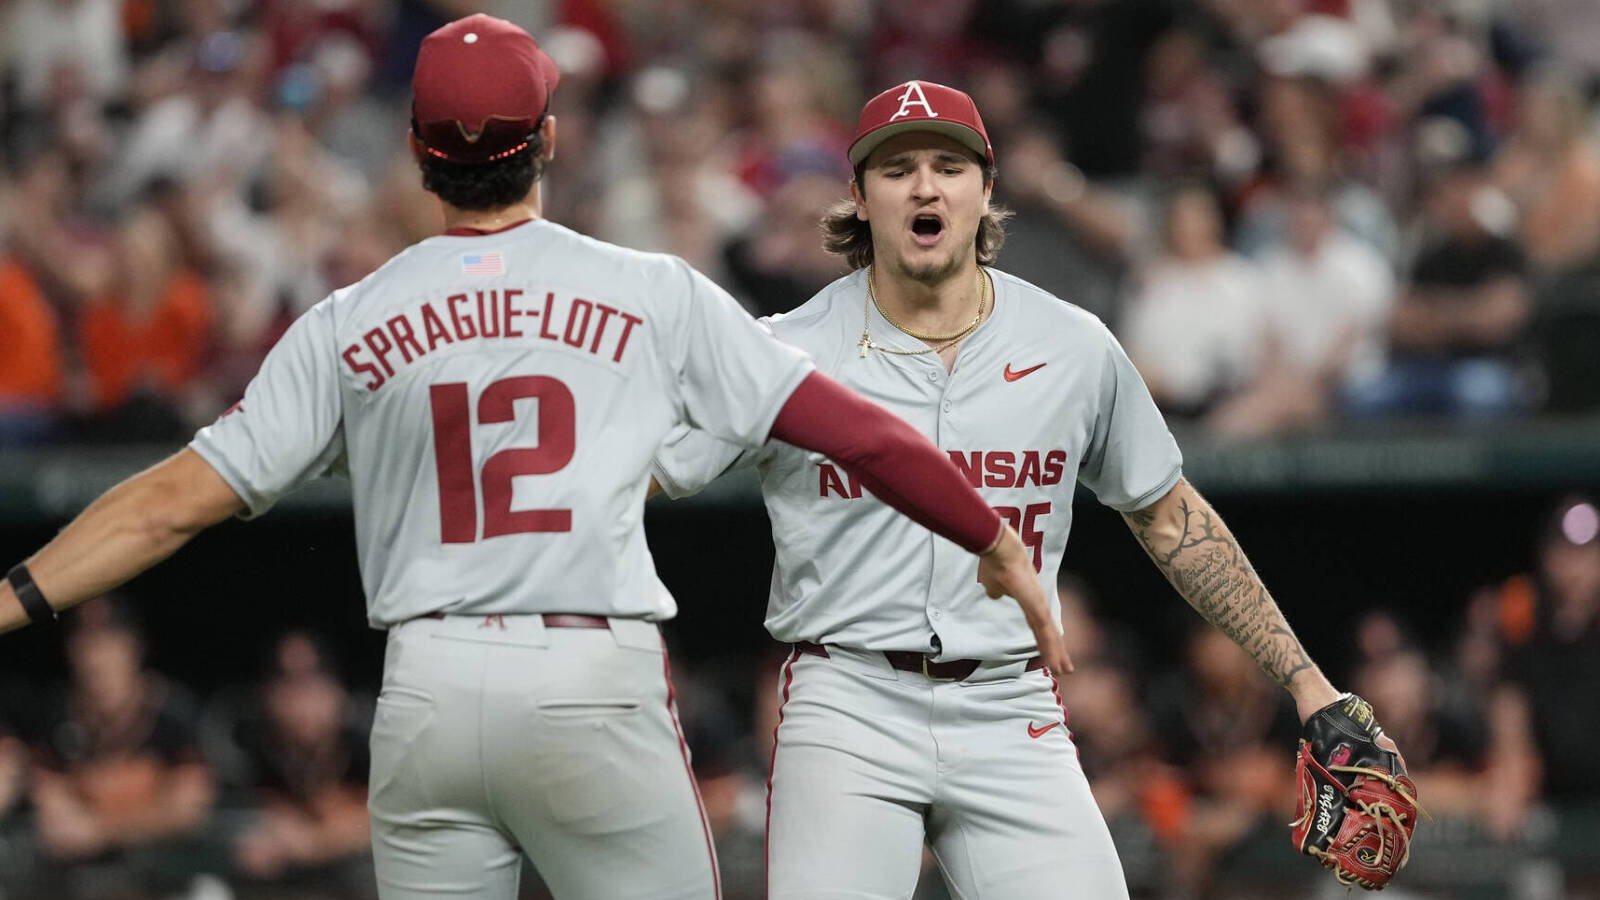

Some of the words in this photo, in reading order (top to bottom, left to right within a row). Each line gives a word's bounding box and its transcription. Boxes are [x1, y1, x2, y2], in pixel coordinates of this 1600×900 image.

[889, 80, 938, 122] A
[342, 289, 643, 391] SPRAGUE-LOTT
[429, 375, 576, 544] 12
[816, 450, 1066, 499] ANSAS
